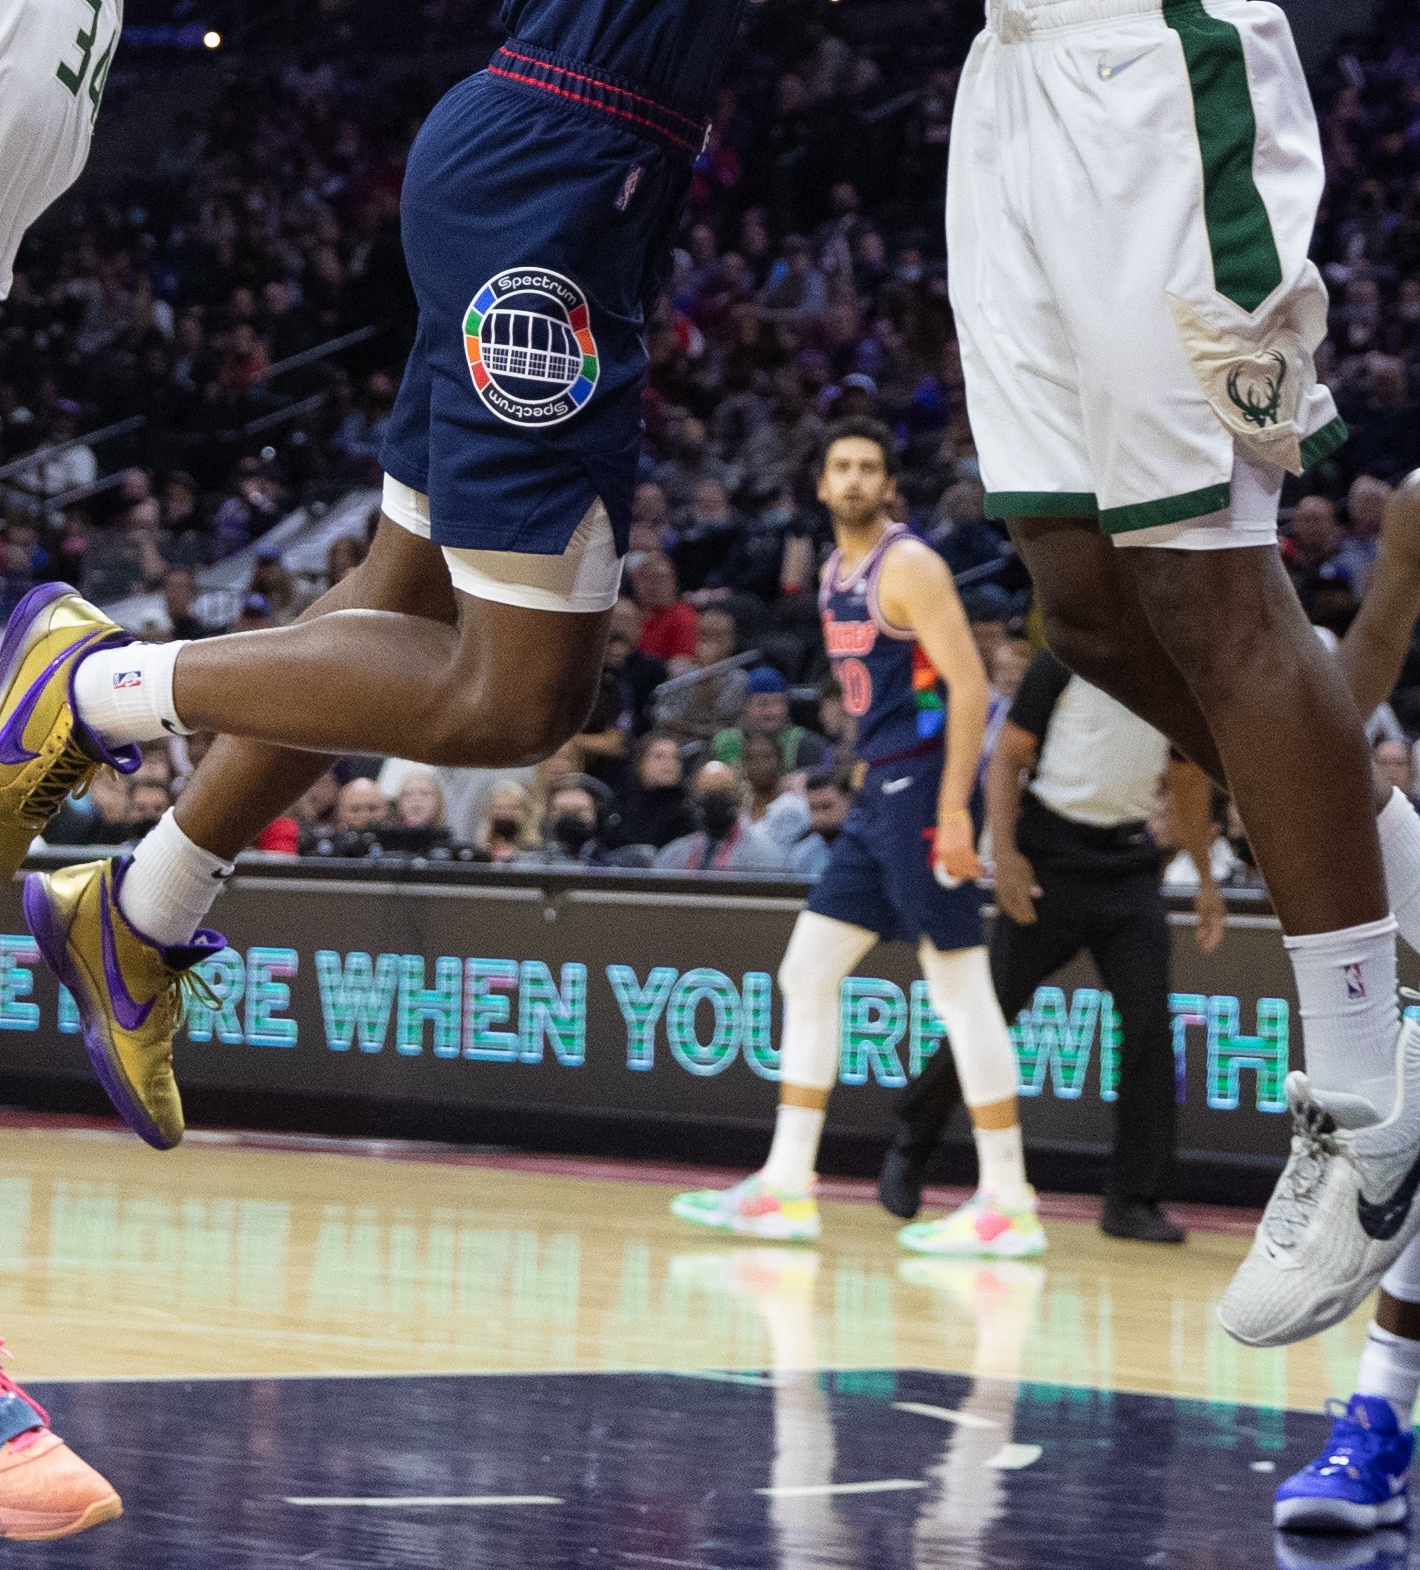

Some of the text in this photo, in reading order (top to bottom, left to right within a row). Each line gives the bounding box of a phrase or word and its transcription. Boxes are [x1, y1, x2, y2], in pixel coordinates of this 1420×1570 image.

[497, 275, 578, 306] Spectrum
[488, 389, 570, 419] Spectrum
[313, 948, 589, 1068] WHEN
